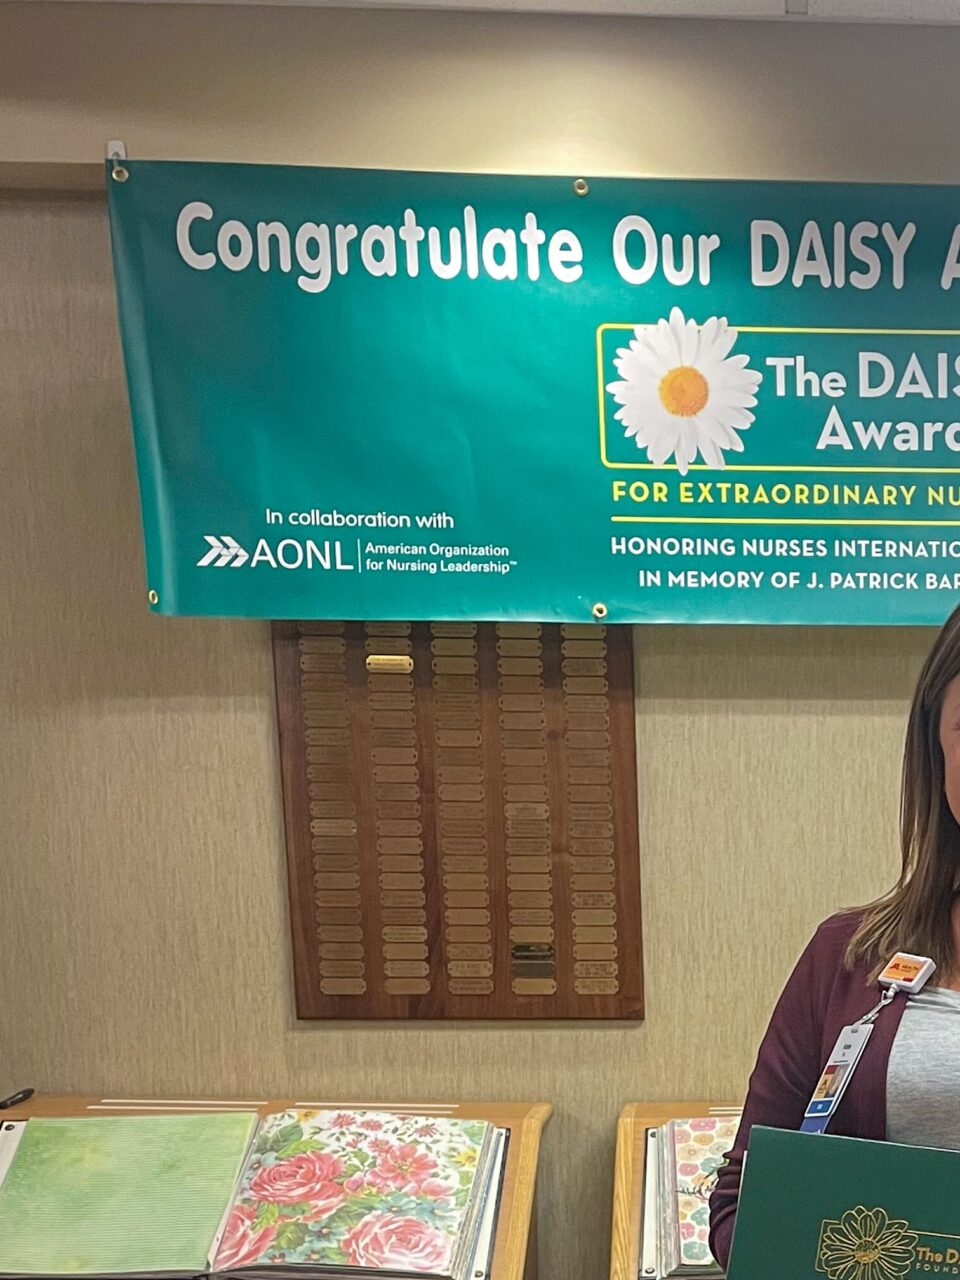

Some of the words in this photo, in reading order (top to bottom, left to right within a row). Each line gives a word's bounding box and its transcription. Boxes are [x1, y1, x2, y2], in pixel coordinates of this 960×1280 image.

[175, 201, 584, 293] Congratulate
[612, 214, 721, 286] Our
[750, 219, 916, 290] DAISY
[765, 354, 847, 398] The
[612, 480, 668, 502] FOR
[679, 482, 917, 506] EXTRAORDINARY
[266, 508, 283, 525] In
[288, 509, 411, 528] collaboration
[415, 511, 454, 529] with
[250, 537, 354, 570] AONL
[365, 542, 426, 556] American
[429, 543, 509, 559] Organization
[610, 536, 736, 556] HONORING
[742, 538, 827, 557] NURSES
[366, 559, 383, 571] for
[386, 559, 437, 574] Nursing
[638, 570, 661, 587] IN
[668, 570, 764, 589] MEMORY
[771, 571, 800, 588] OF
[806, 571, 824, 589] J.
[830, 572, 919, 590] PATRICK
[916, 1247, 943, 1263] The
